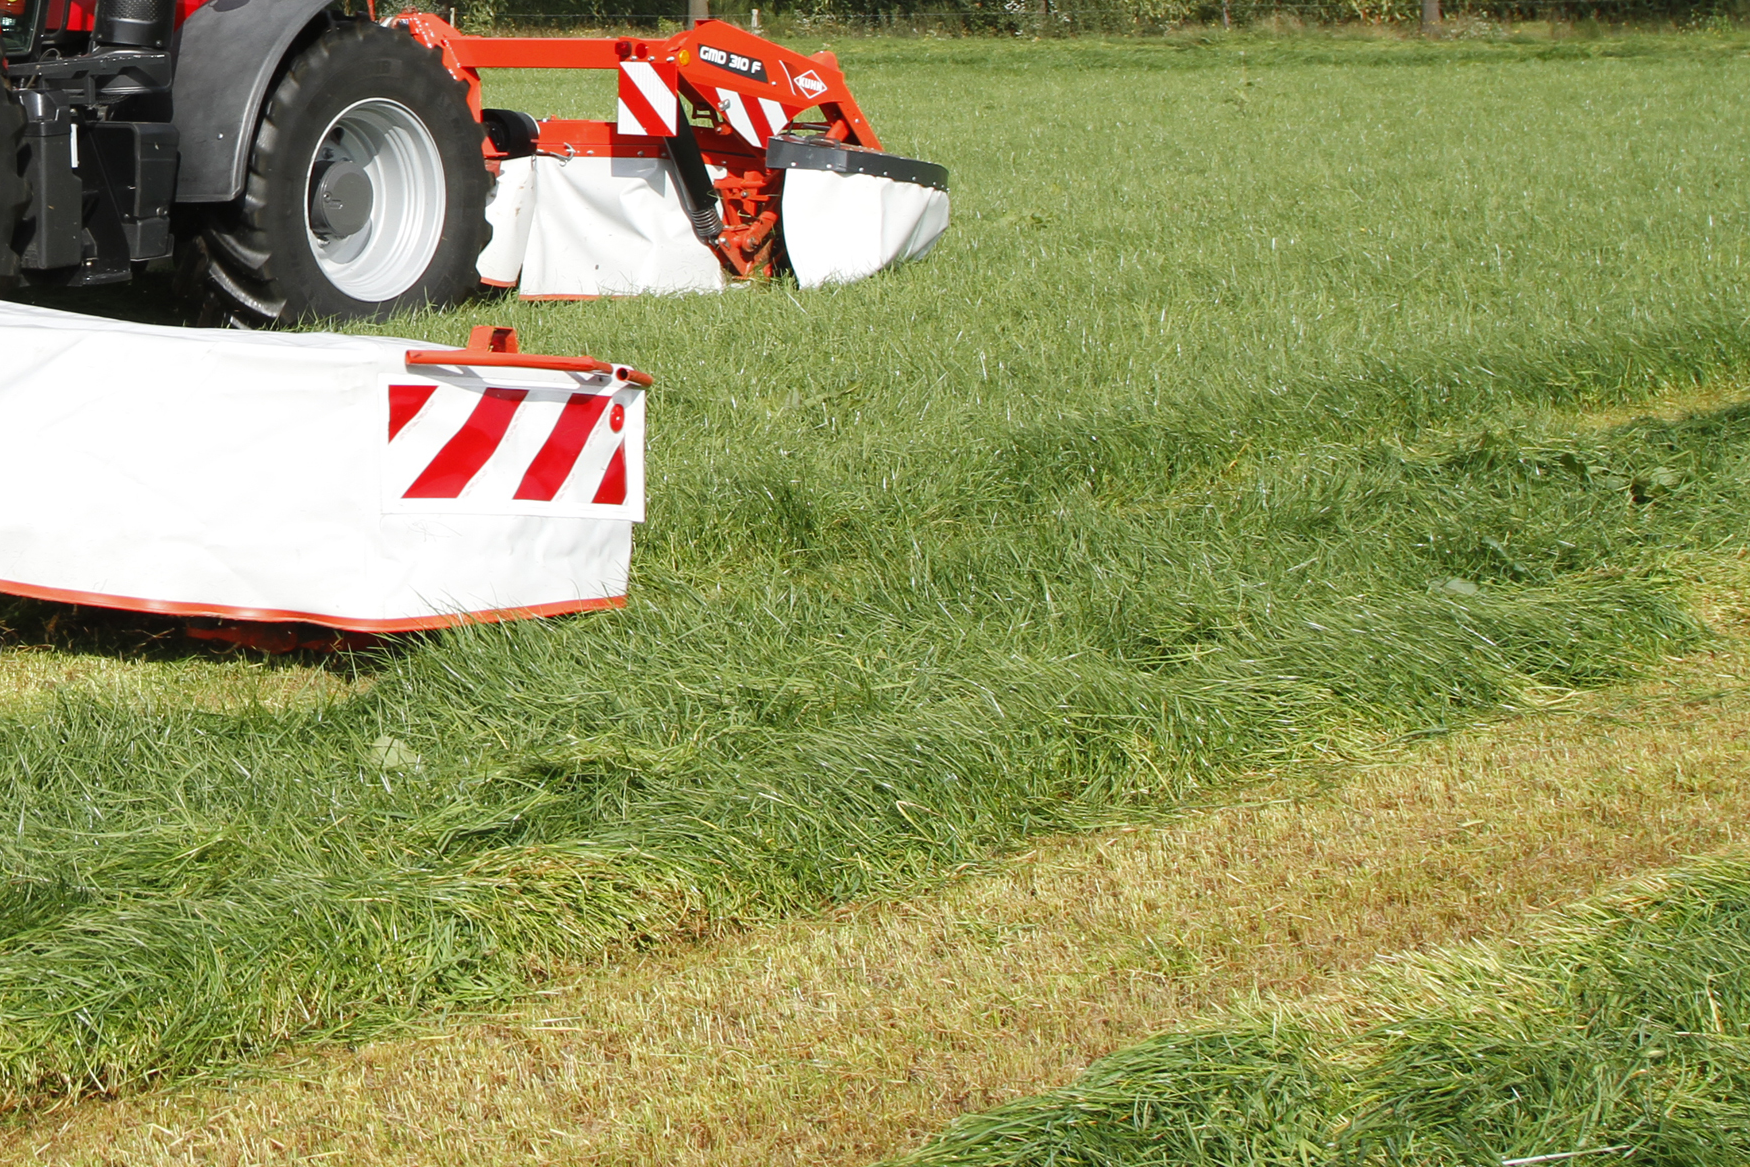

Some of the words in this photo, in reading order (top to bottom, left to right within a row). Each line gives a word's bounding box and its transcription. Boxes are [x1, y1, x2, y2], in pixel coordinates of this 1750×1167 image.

[699, 46, 727, 65] GMD
[728, 54, 750, 72] 310
[751, 61, 762, 74] F
[798, 76, 824, 92] KUHN
